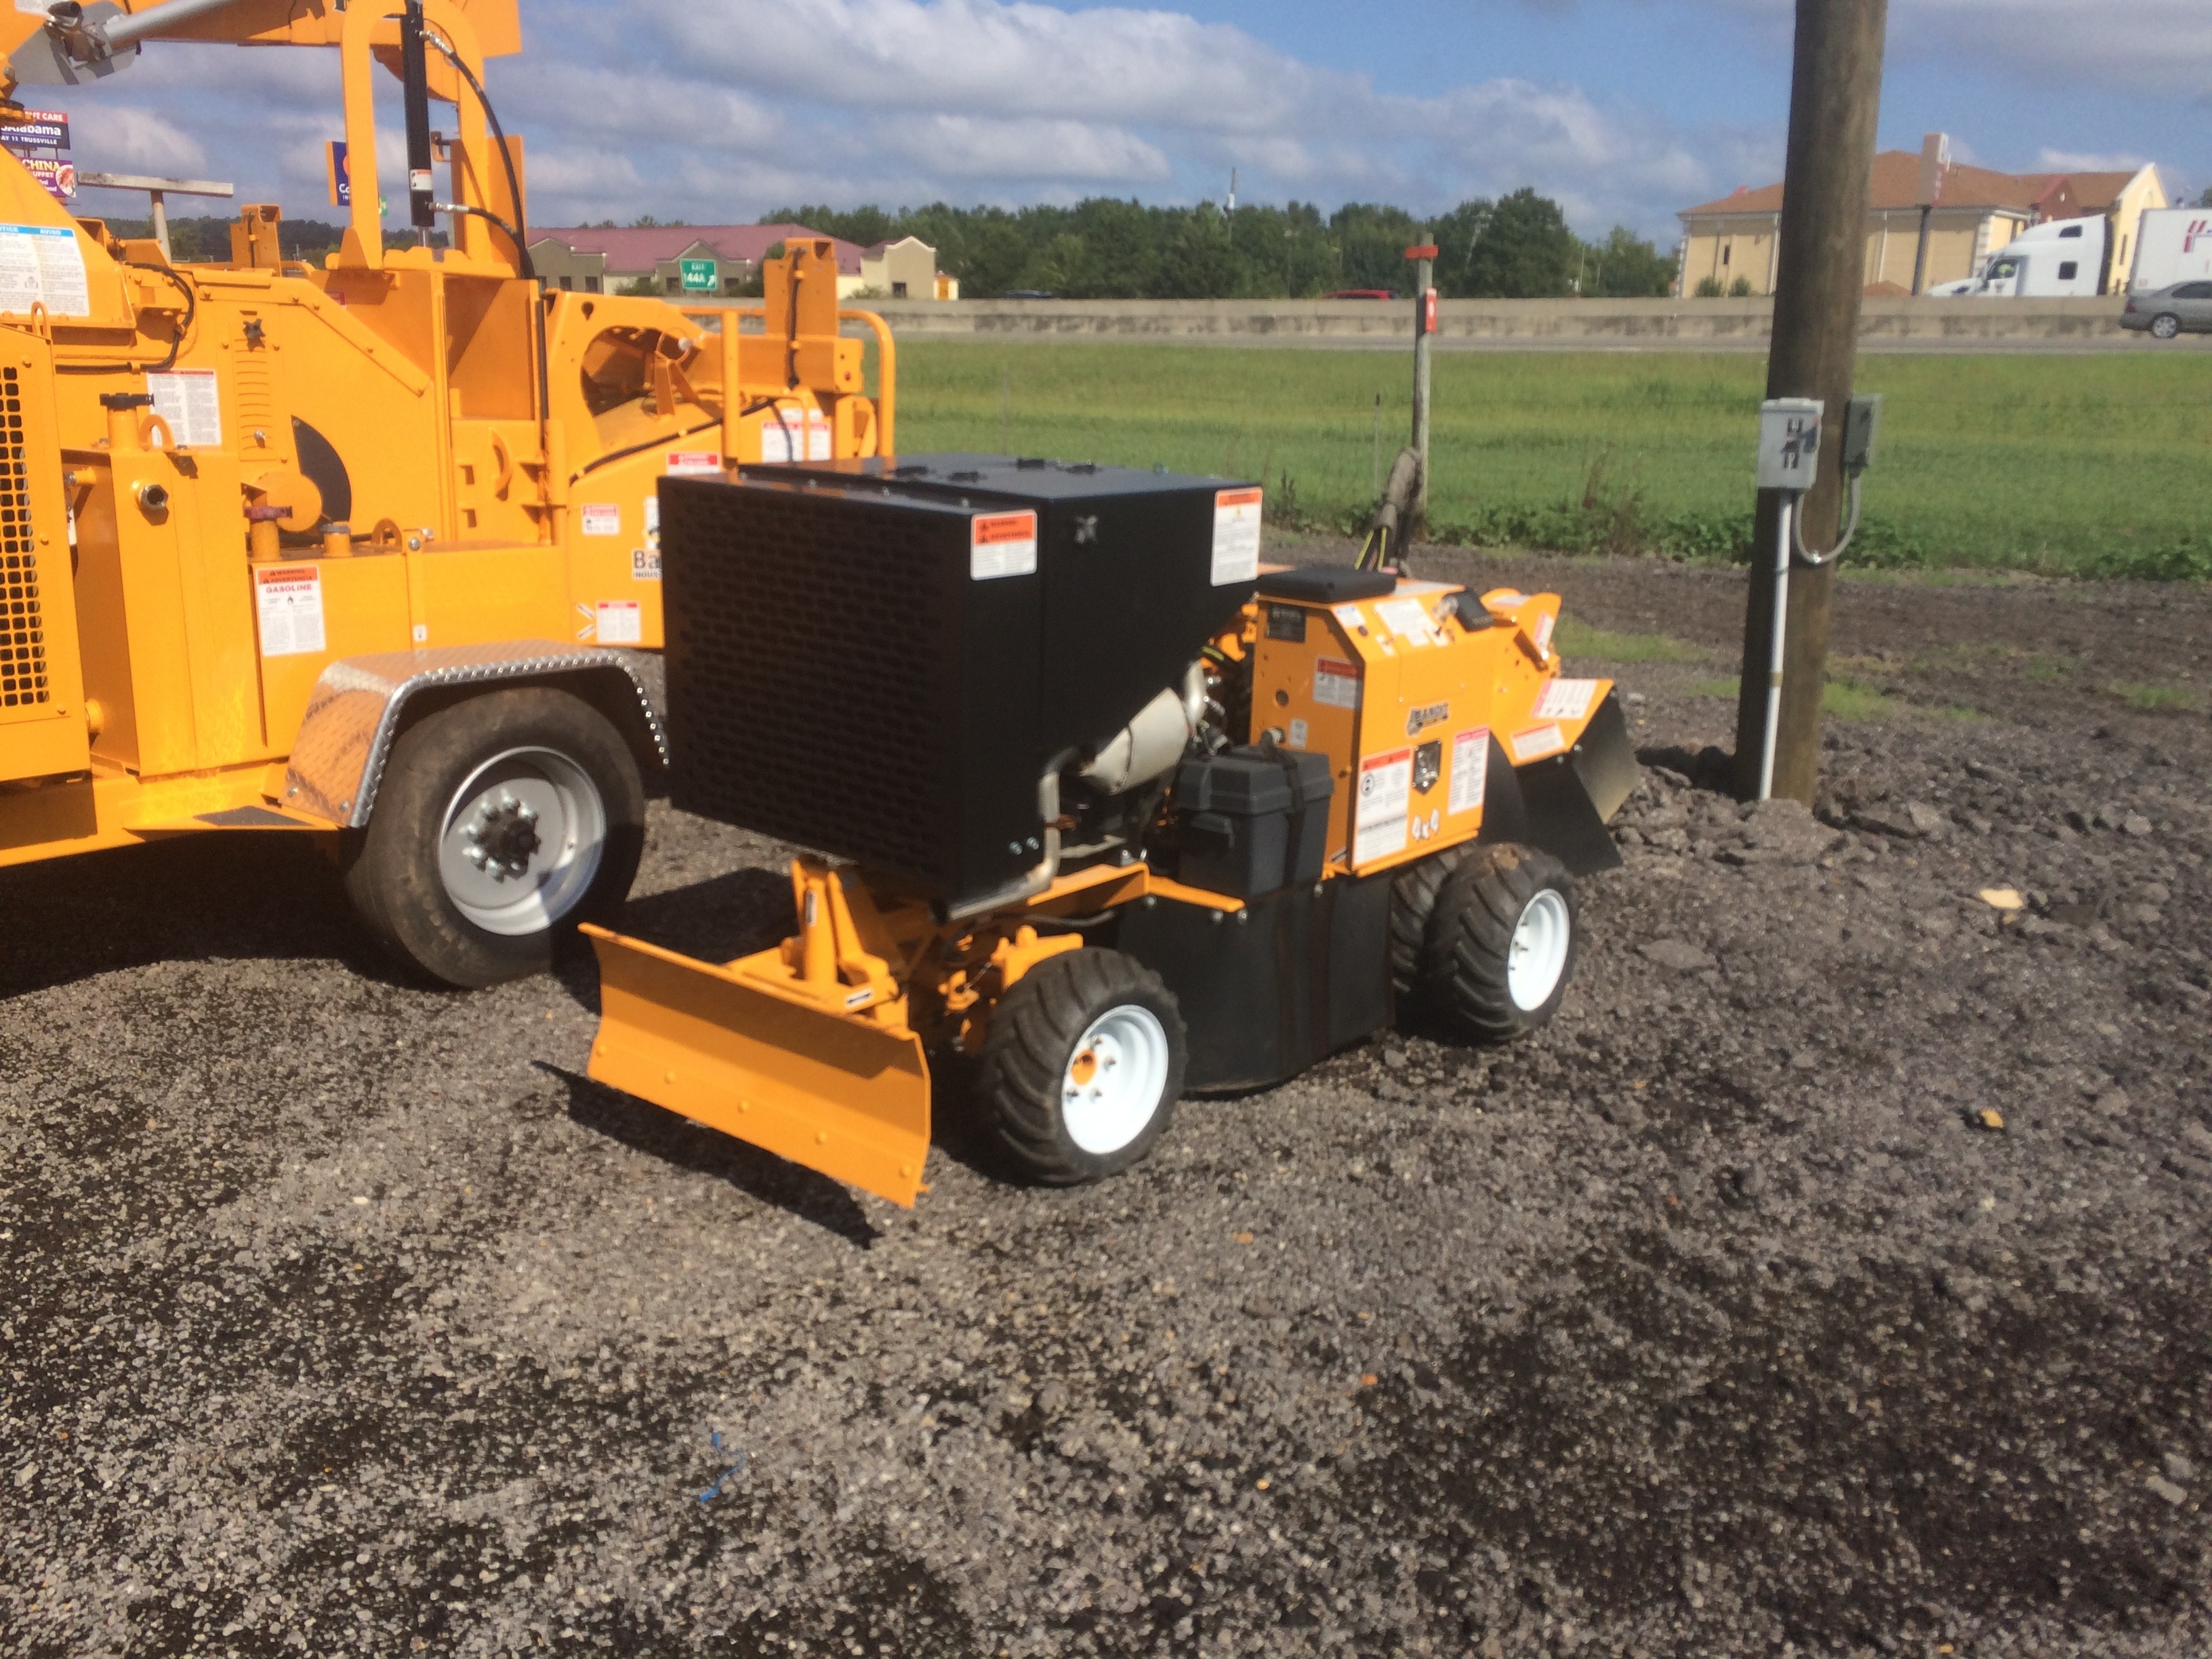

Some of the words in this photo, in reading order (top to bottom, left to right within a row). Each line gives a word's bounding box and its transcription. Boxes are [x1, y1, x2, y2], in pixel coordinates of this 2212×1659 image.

[42, 113, 63, 121] CARE
[21, 136, 58, 145] TRUSSVILLE
[22, 159, 60, 171] CHINA
[266, 584, 312, 593] GASOLINE
